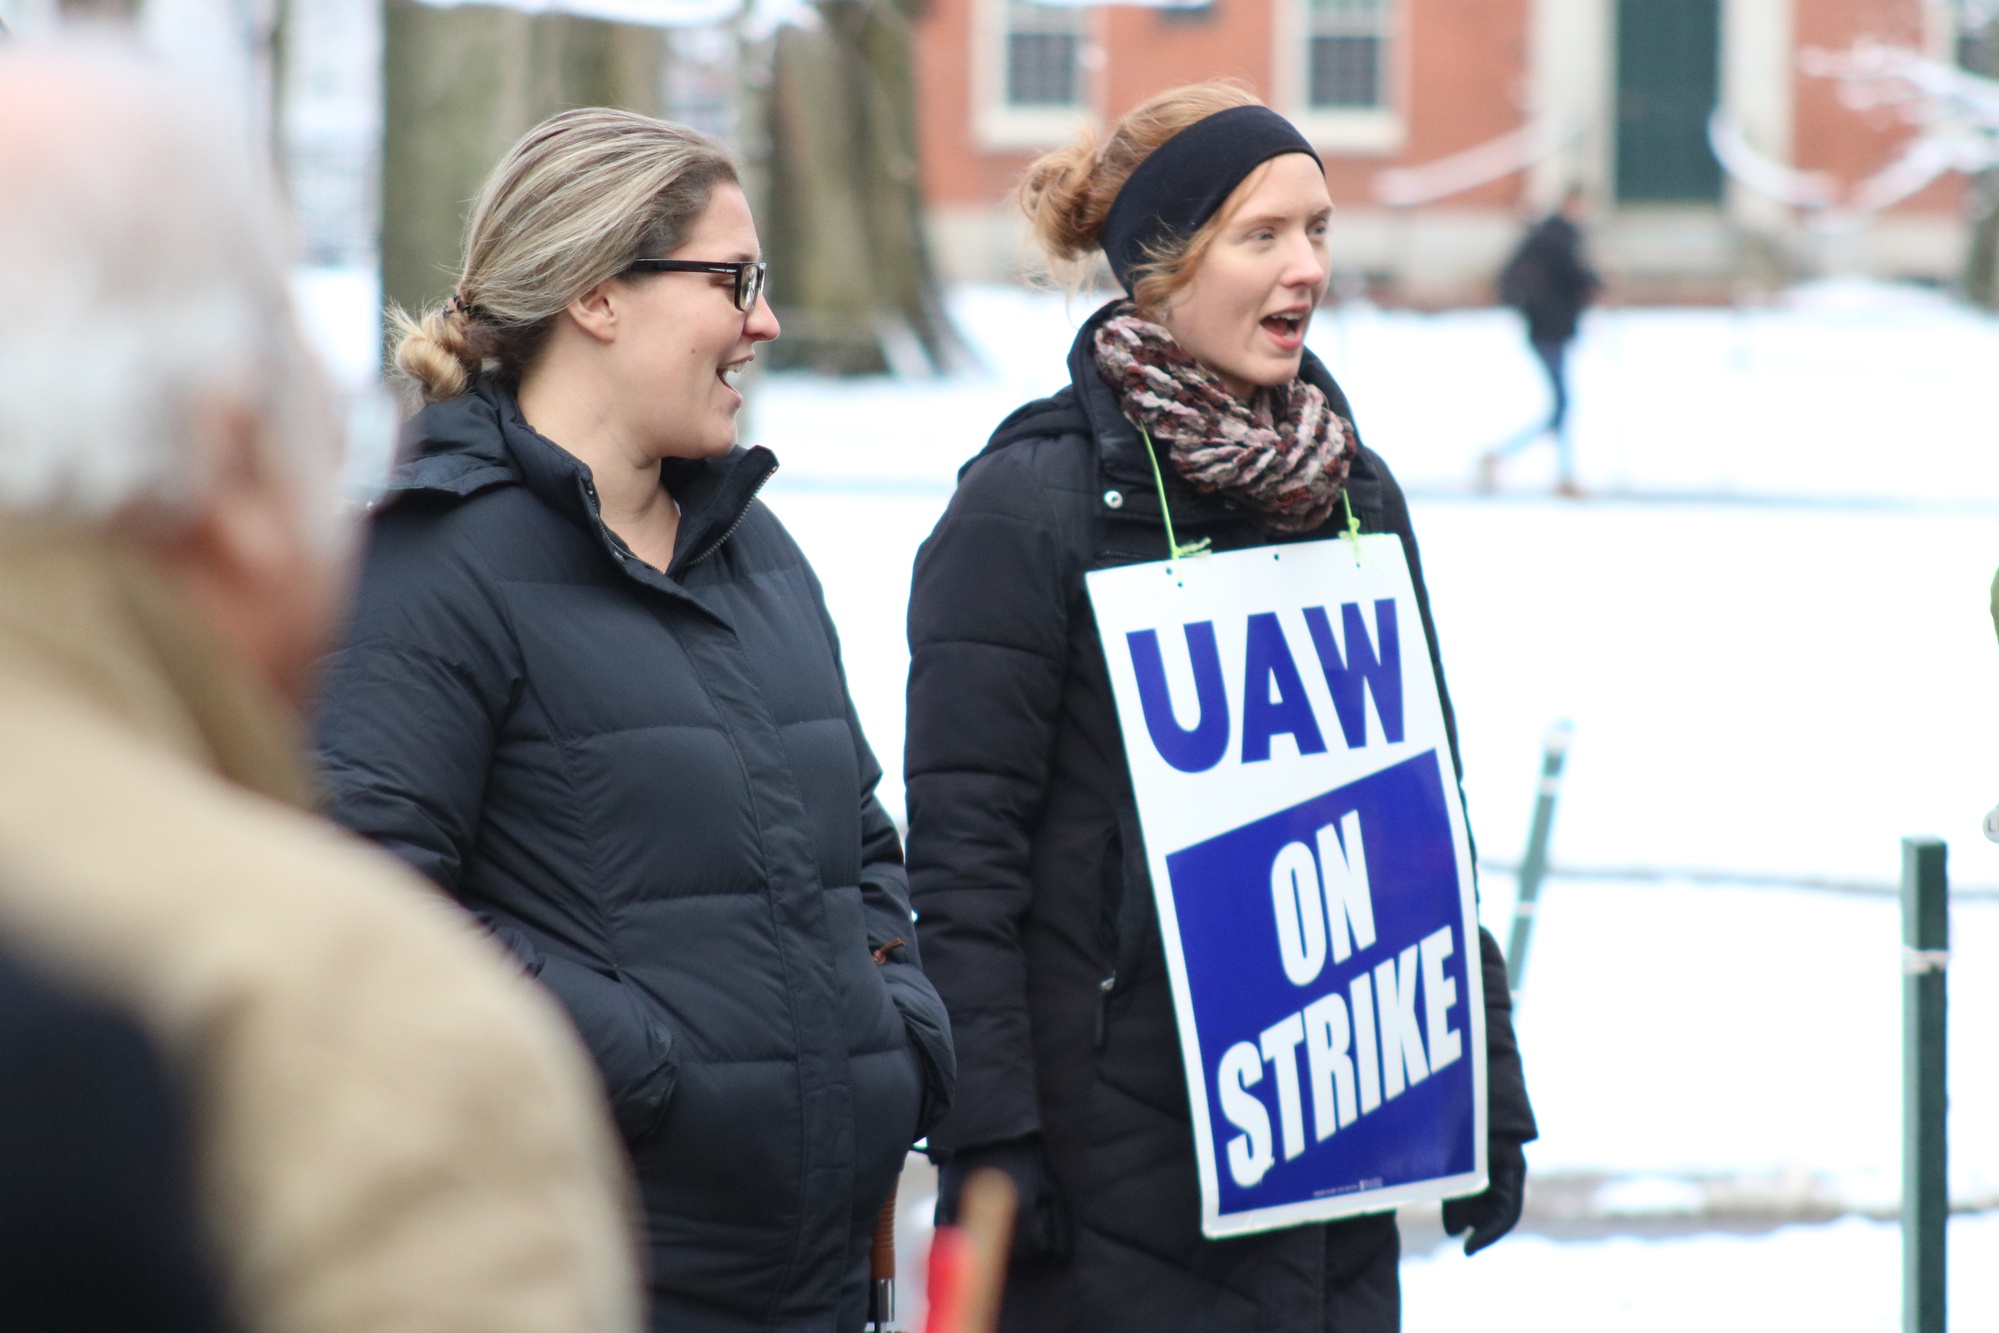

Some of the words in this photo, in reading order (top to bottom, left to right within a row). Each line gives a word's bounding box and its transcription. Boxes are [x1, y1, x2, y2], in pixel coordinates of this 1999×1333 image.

[1125, 598, 1404, 773] UAW
[1271, 810, 1376, 986] ON
[1218, 925, 1462, 1187] STRIKE
